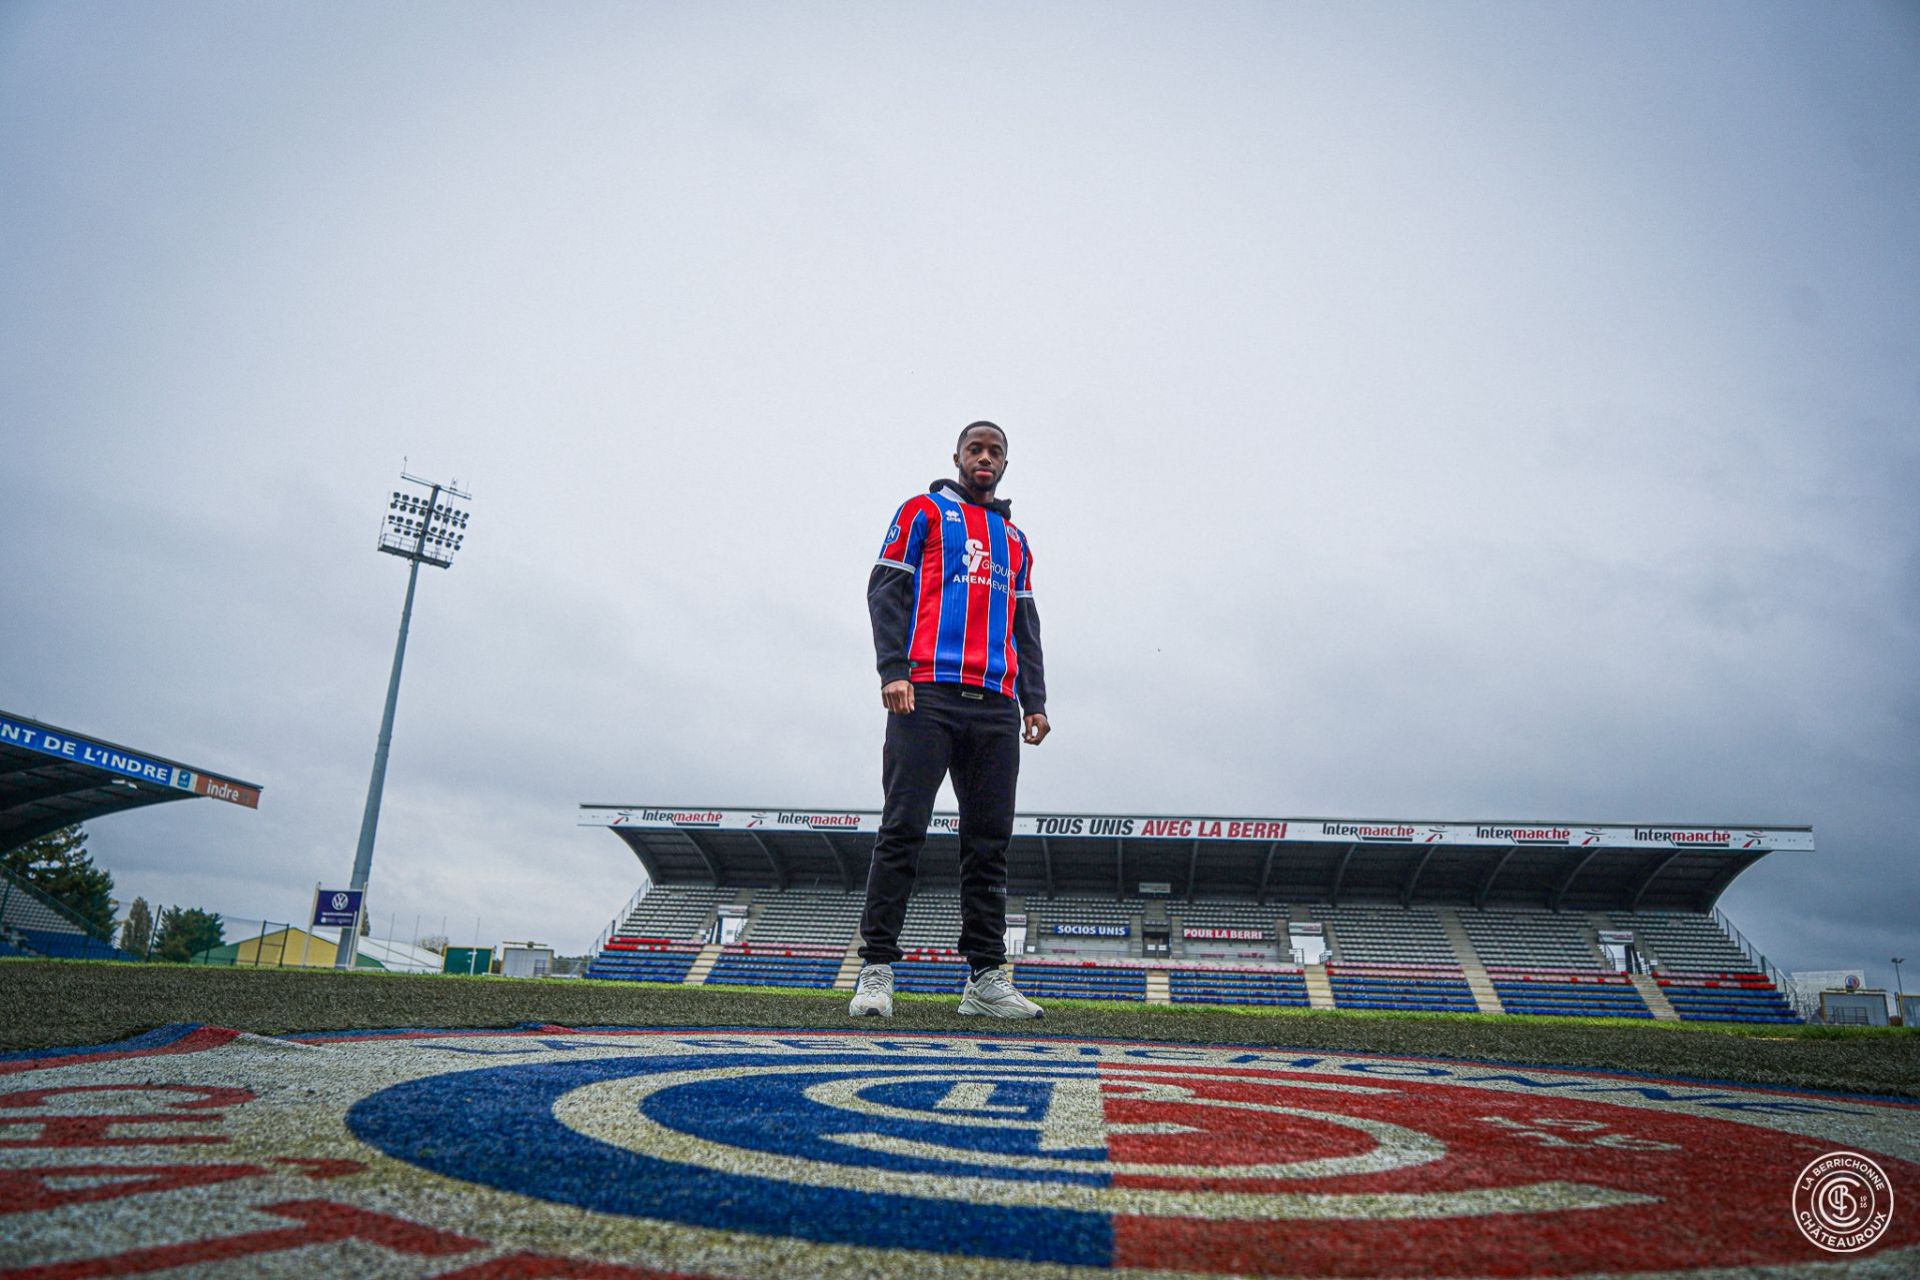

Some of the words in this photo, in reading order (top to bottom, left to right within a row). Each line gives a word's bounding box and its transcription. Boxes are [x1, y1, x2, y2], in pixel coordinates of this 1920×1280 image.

[0, 722, 36, 743] NT
[43, 735, 76, 756] DE
[84, 747, 168, 781] L'INDRE
[206, 779, 240, 801] indre
[1035, 818, 1083, 835] TOUS
[1089, 819, 1134, 836] UNIS
[1141, 820, 1192, 837] AVEC
[1197, 821, 1222, 837] LA
[1227, 821, 1288, 839] BERRI
[1057, 925, 1096, 935] SOCIOS
[1098, 926, 1126, 936] UNIS
[1183, 928, 1212, 938] POUR
[1214, 929, 1229, 938] LA
[1230, 930, 1263, 939] BERRI
